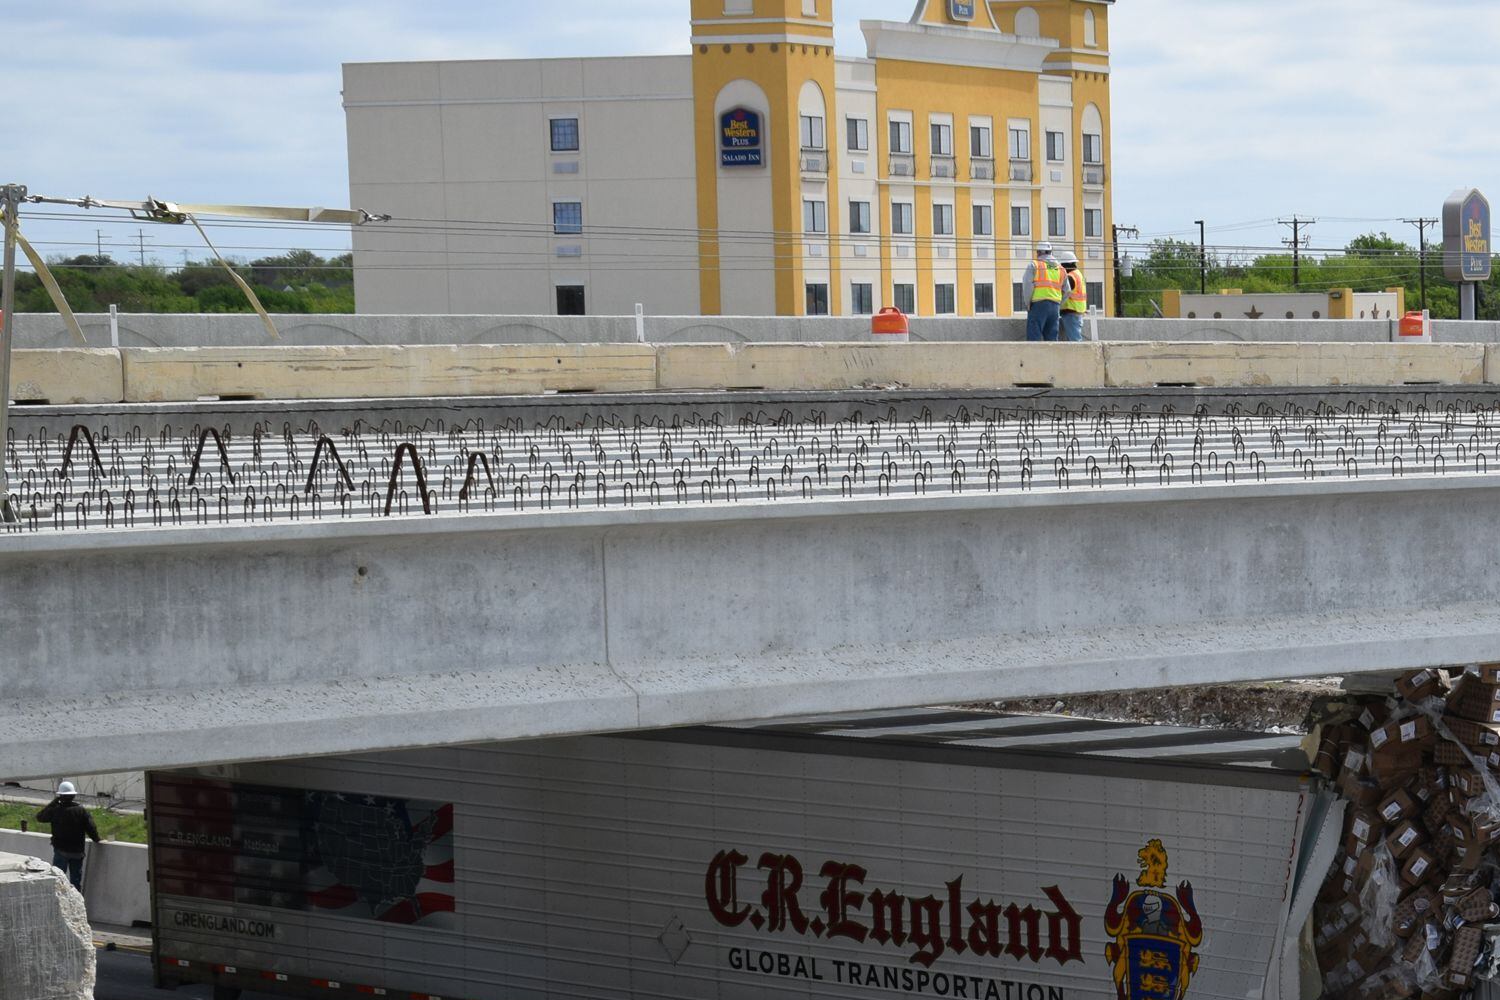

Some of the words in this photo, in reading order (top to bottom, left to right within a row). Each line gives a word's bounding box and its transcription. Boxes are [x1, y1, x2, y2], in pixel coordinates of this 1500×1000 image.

[724, 127, 756, 137] Western
[730, 119, 749, 129] Best
[1468, 218, 1482, 237] Best
[1464, 234, 1488, 253] Western
[174, 910, 276, 938] CRENGLAND.COM
[728, 947, 824, 981] GLOBAL
